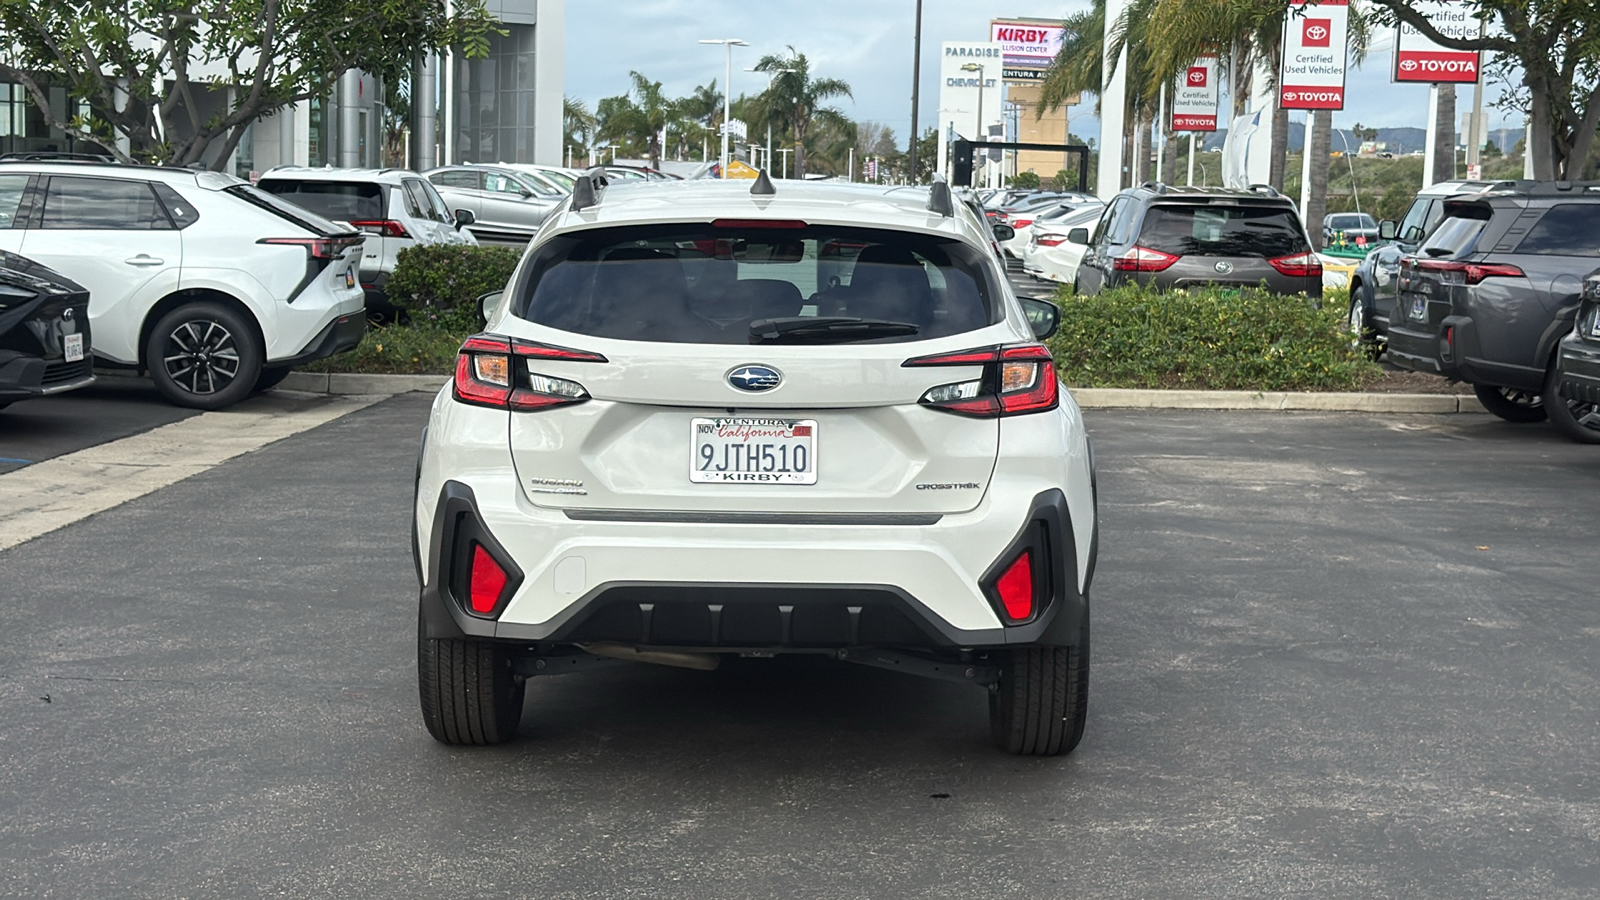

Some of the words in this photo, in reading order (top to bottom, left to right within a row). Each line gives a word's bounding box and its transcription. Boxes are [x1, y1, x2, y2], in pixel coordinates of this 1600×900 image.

[1425, 12, 1465, 21] rtified
[1402, 25, 1421, 35] Use
[997, 28, 1048, 43] KIRBY
[945, 47, 999, 57] PARADISE
[1295, 55, 1333, 63] Certified
[1308, 66, 1343, 74] Vehicles
[1419, 60, 1475, 72] TOYOTA
[1002, 70, 1034, 78] ENTURA
[1298, 92, 1341, 102] TOYOTA
[1185, 118, 1215, 126] TOYOTA
[698, 425, 714, 434] NOV
[718, 425, 793, 442] California
[700, 443, 807, 472] 9JTH510
[722, 473, 784, 481] KIRBY
[531, 477, 583, 487] SUBARU
[915, 482, 980, 490] CROSSTREK
